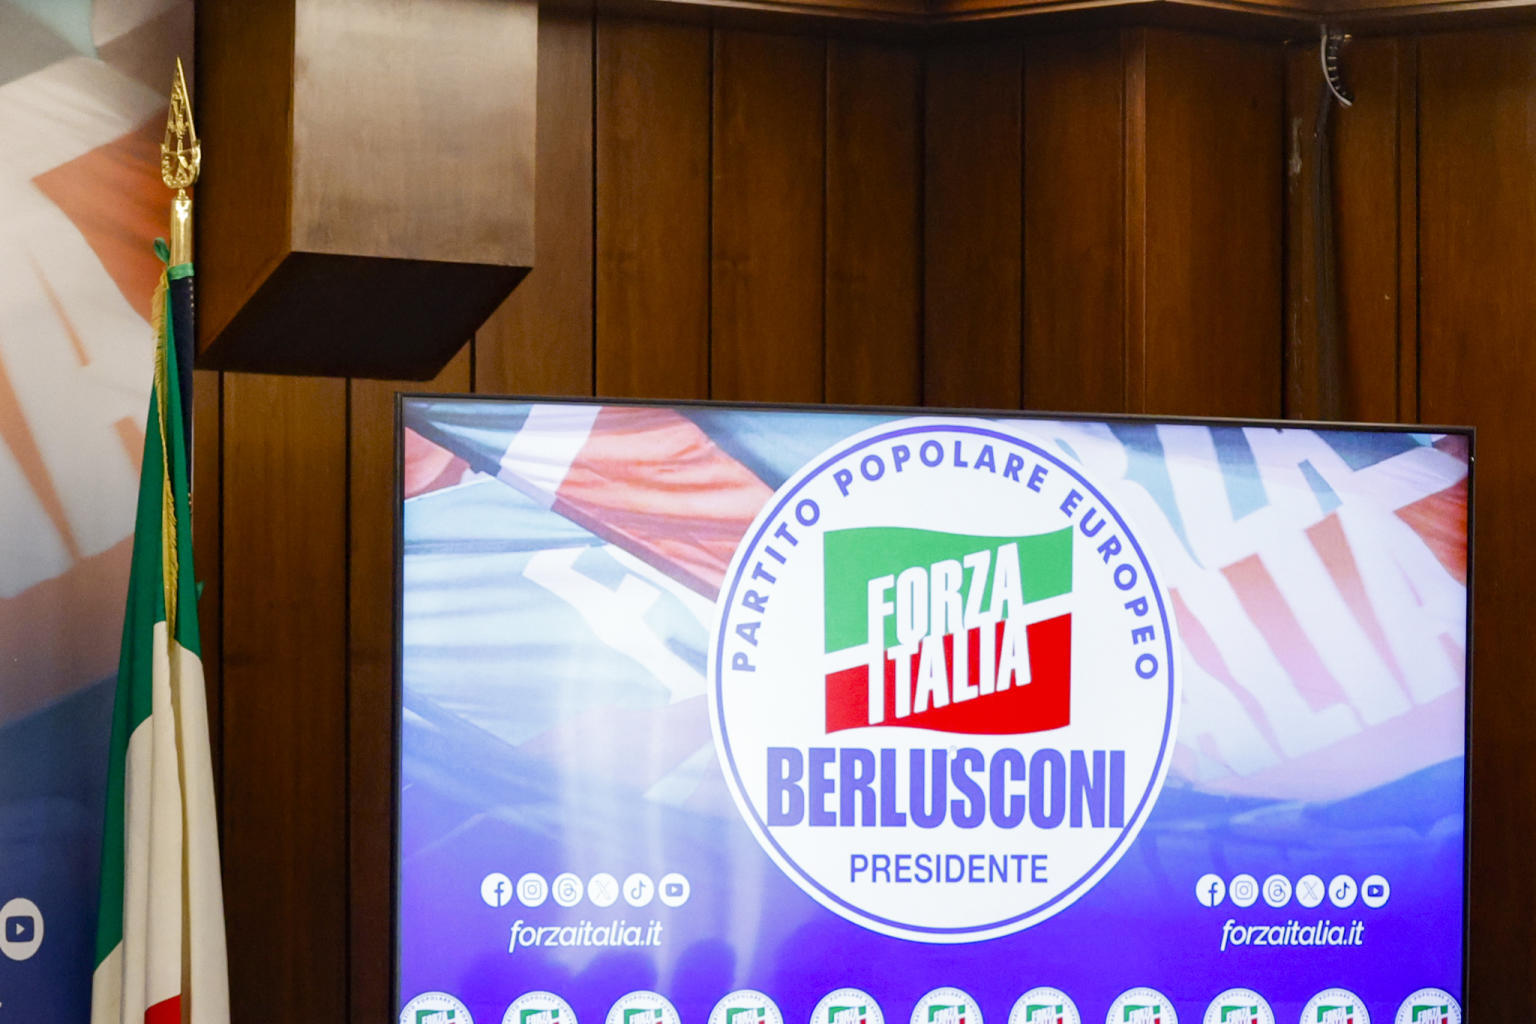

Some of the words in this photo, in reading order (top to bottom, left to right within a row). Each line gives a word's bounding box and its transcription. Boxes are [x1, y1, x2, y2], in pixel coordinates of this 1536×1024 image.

[732, 499, 820, 672] PARTITO
[833, 440, 1049, 497] POPOLARE
[1059, 489, 1159, 680] EUROPEO
[868, 542, 1024, 648] FORZA
[868, 614, 1032, 725] ITALIA
[766, 747, 1125, 829] BERLUSCONI
[850, 854, 1048, 883] PRESIDENTE
[508, 920, 663, 953] forzaitalia.it
[1220, 919, 1364, 951] forzaitalia.it
